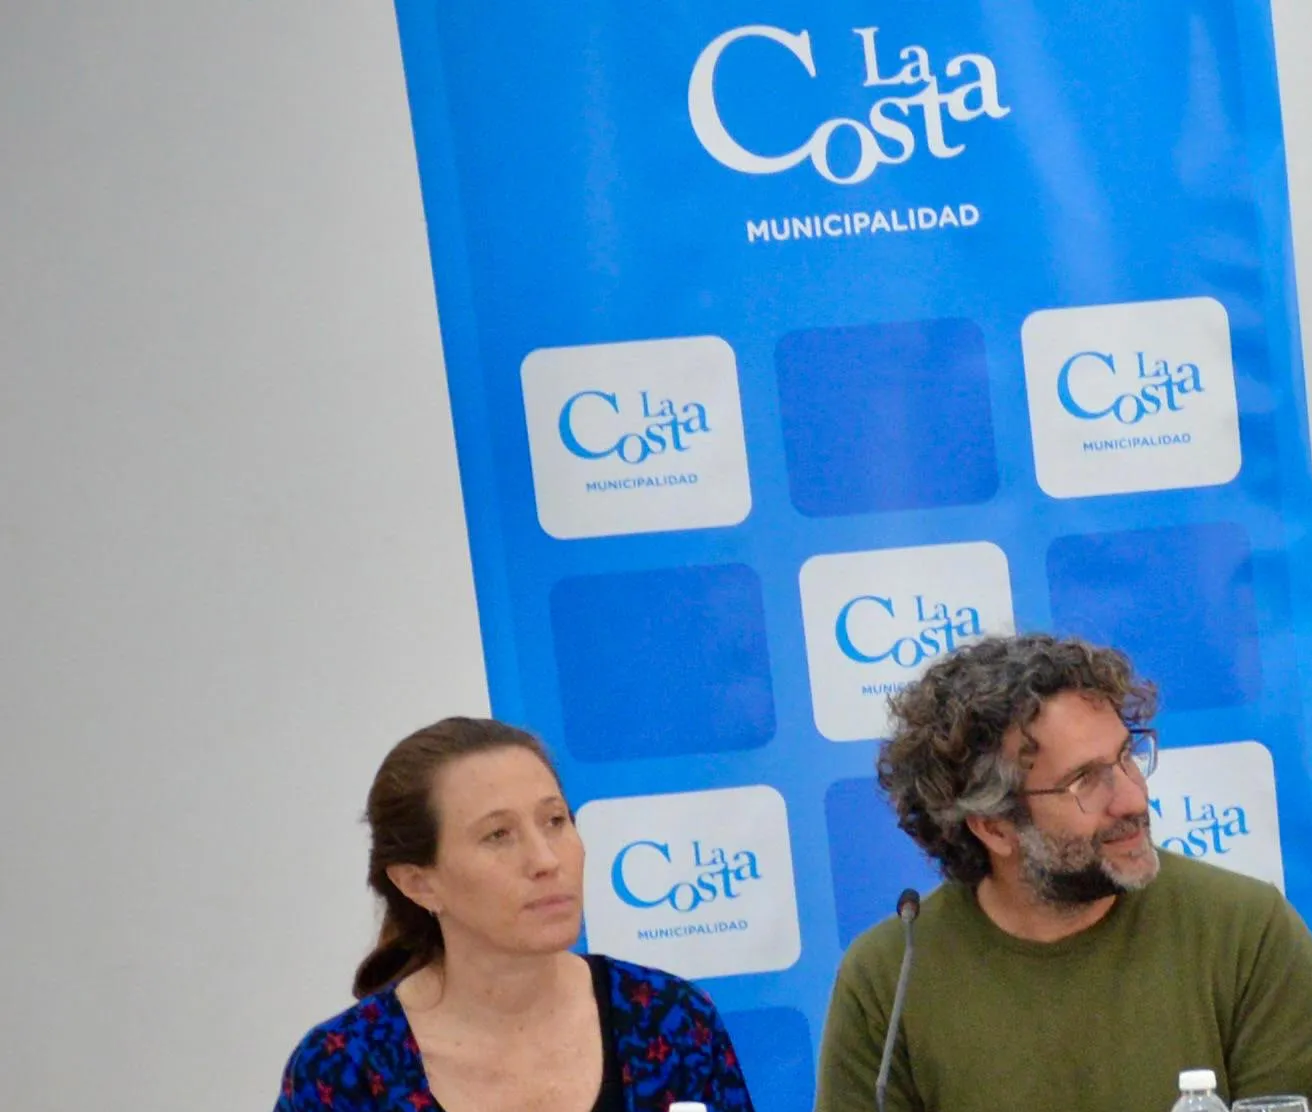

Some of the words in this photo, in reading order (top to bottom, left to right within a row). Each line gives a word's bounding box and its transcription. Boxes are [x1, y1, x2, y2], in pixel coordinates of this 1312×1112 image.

[853, 26, 933, 88] La
[687, 24, 1011, 185] Costa
[746, 203, 980, 243] MUNICIPALIDAD
[1136, 350, 1170, 379] La
[1056, 350, 1206, 425] Costa
[639, 389, 674, 418] La
[557, 389, 711, 465] Costa
[1082, 433, 1193, 453] MUNICIPALIDAD
[585, 472, 699, 493] MUNICIPALIDAD
[913, 593, 948, 622] La
[833, 594, 985, 669] Costa
[1182, 794, 1216, 823] La
[690, 839, 725, 868] La
[609, 839, 762, 914] Costa
[637, 919, 749, 941] MUNICIPALIDAD
